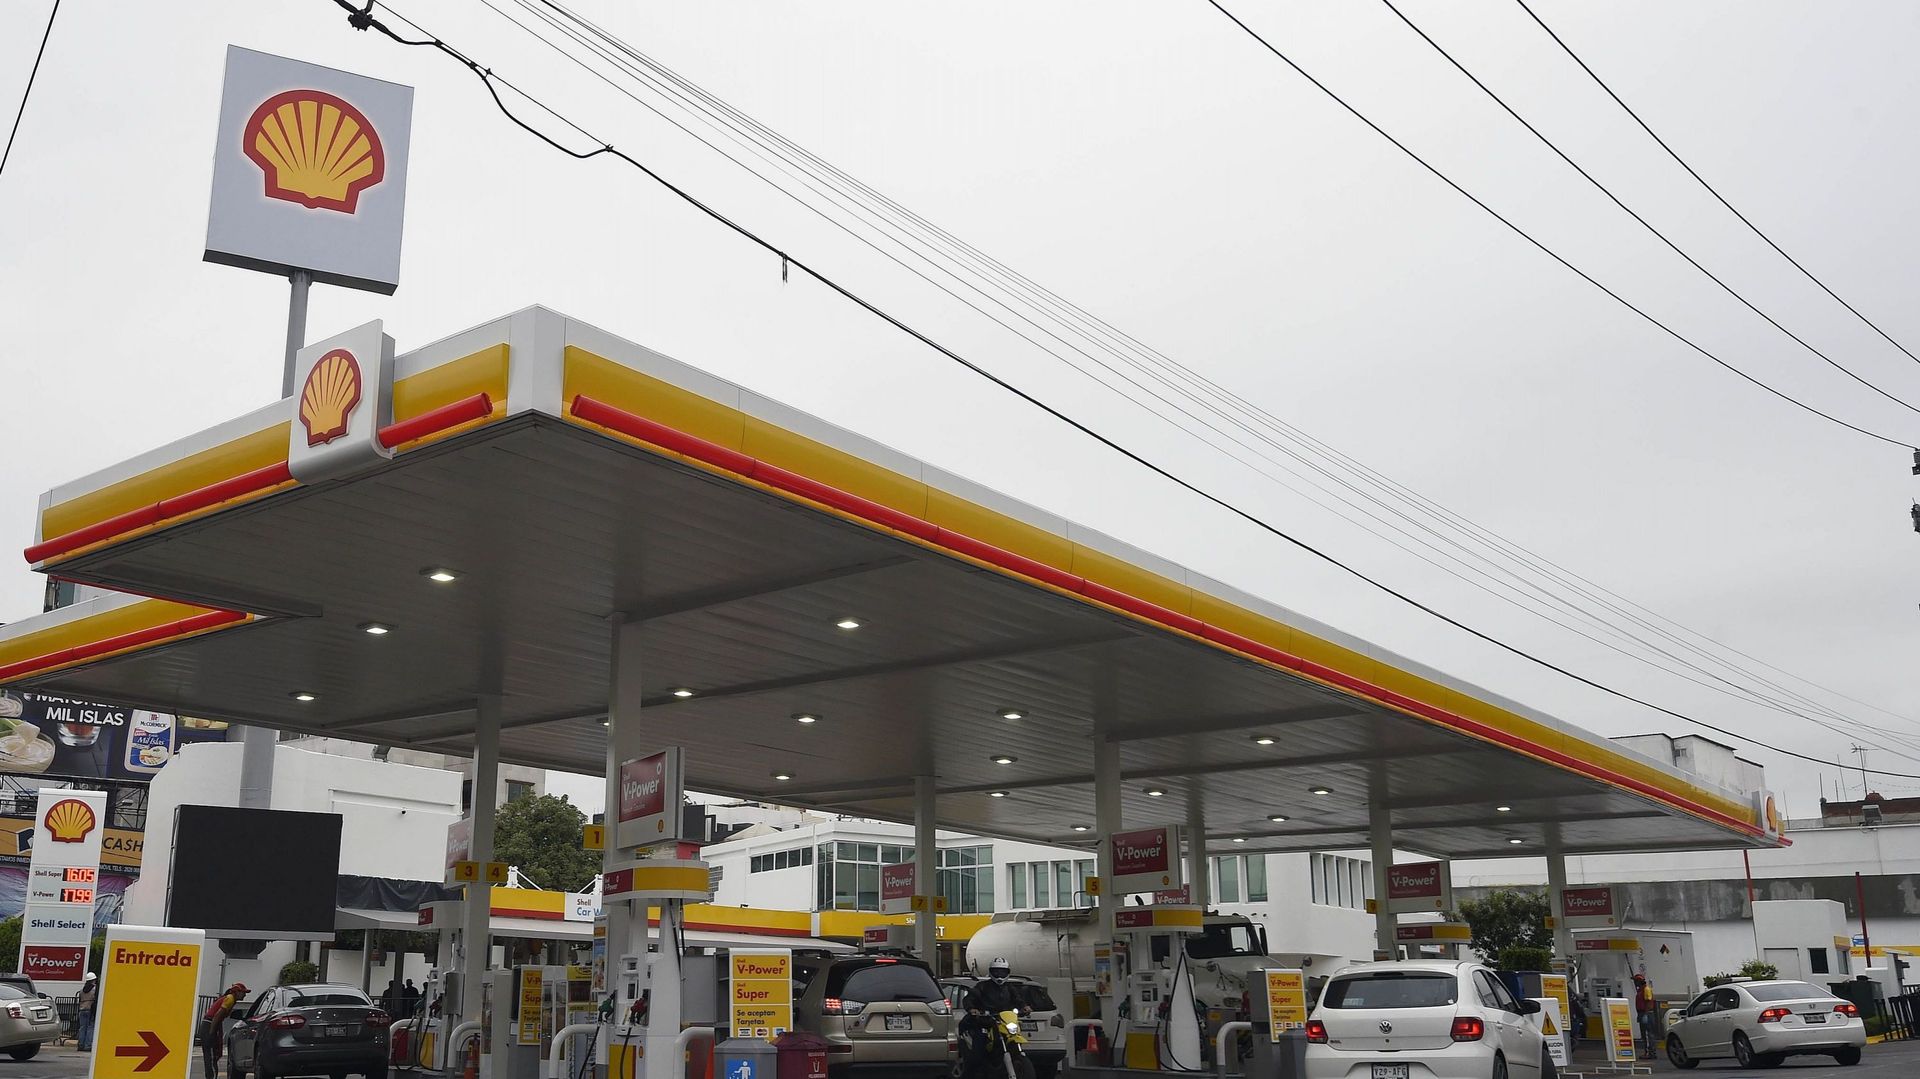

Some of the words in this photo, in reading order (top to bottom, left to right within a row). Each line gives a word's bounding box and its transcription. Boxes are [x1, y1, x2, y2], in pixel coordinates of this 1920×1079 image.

[46, 706, 75, 722] MIL
[79, 709, 124, 726] ISLAS
[623, 779, 660, 801] V-Power
[1117, 845, 1161, 860] V-Power
[464, 865, 473, 877] 3
[492, 867, 500, 878] 4
[884, 877, 912, 888] V-Power
[1091, 881, 1098, 891] 5
[1391, 876, 1435, 887] V-Power
[576, 898, 592, 906] Shell
[1567, 898, 1606, 907] V-Power
[576, 906, 591, 916] Car
[31, 919, 55, 928] Shell
[57, 920, 86, 929] Select
[28, 957, 78, 967] V-Power
[115, 948, 192, 967] Entrada
[737, 965, 784, 975] V-Power
[525, 992, 541, 1005] Sup
[736, 989, 770, 1001] Super
[747, 1010, 776, 1018] aceptan
[736, 1018, 765, 1027] Tarjetas
